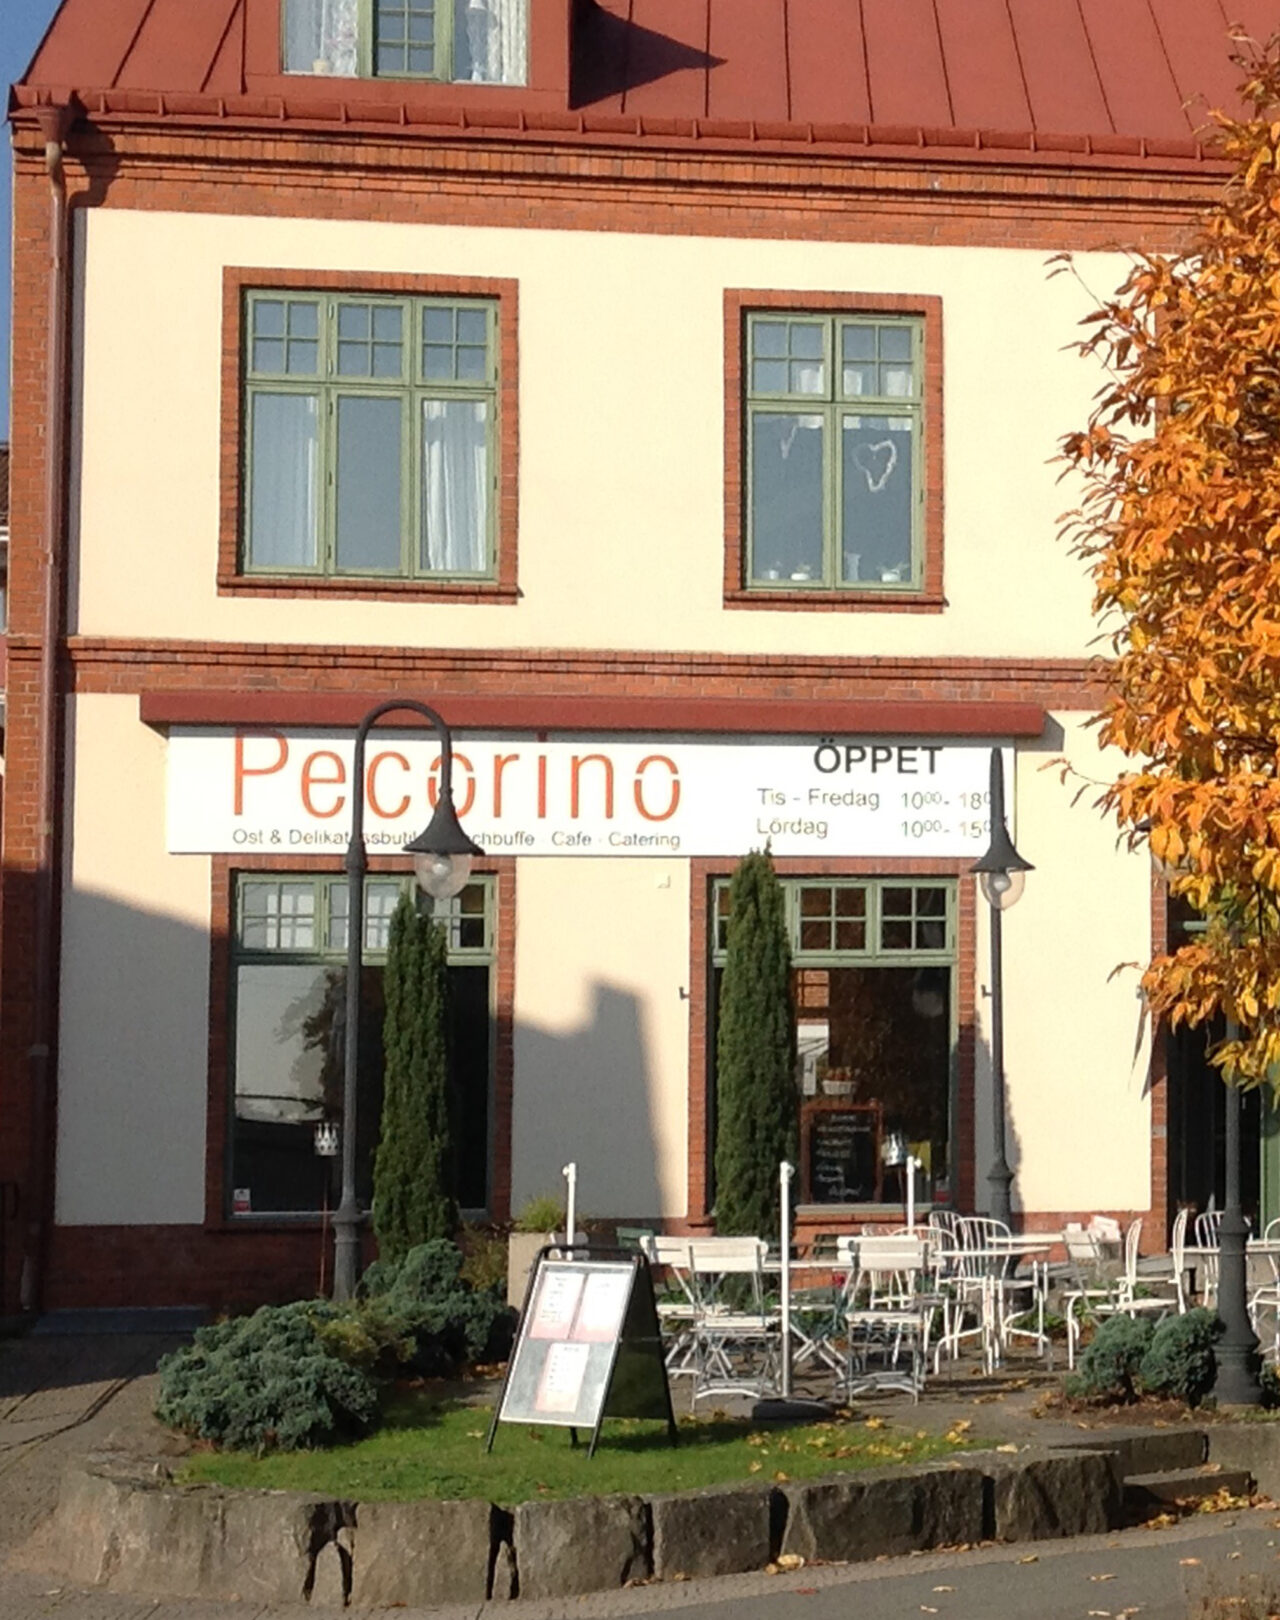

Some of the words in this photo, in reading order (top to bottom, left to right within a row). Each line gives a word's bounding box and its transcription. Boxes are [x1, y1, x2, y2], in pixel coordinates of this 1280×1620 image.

[813, 737, 944, 774] ÖPPET
[233, 727, 682, 822] Pecorino
[757, 788, 786, 806] Tis
[808, 788, 880, 811] Fredag
[757, 817, 828, 839] Lördag
[232, 829, 263, 844] Ost
[270, 829, 282, 845] &
[608, 832, 681, 851] Catering
